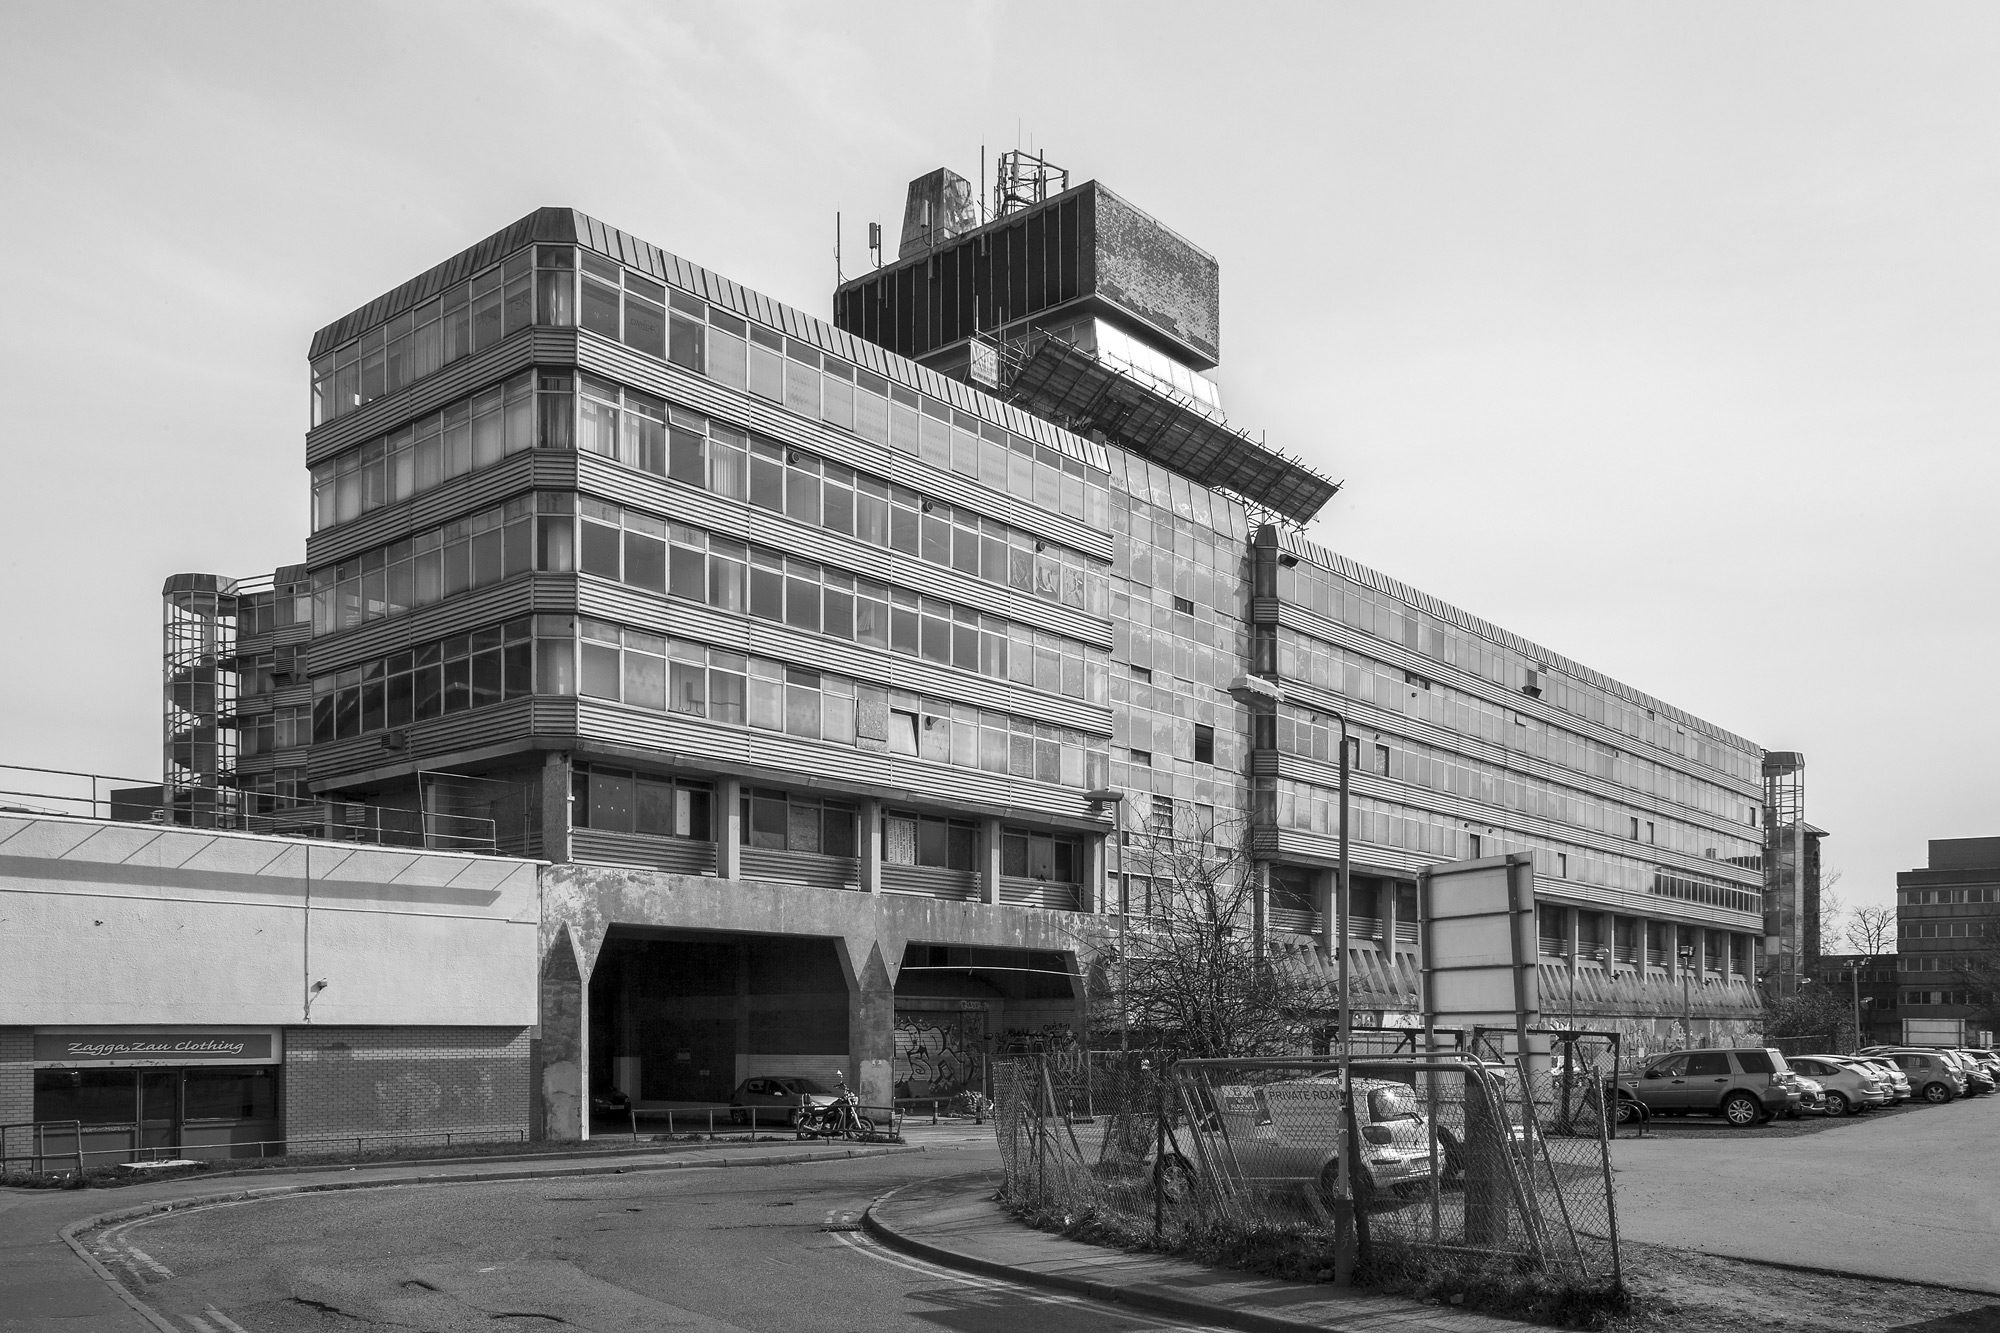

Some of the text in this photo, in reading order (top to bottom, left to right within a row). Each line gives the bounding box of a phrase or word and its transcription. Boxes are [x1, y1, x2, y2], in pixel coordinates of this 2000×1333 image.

[131, 1042, 172, 1051] Zau
[174, 1039, 245, 1055] Clothing
[1269, 1090, 1311, 1100] PRIVATE
